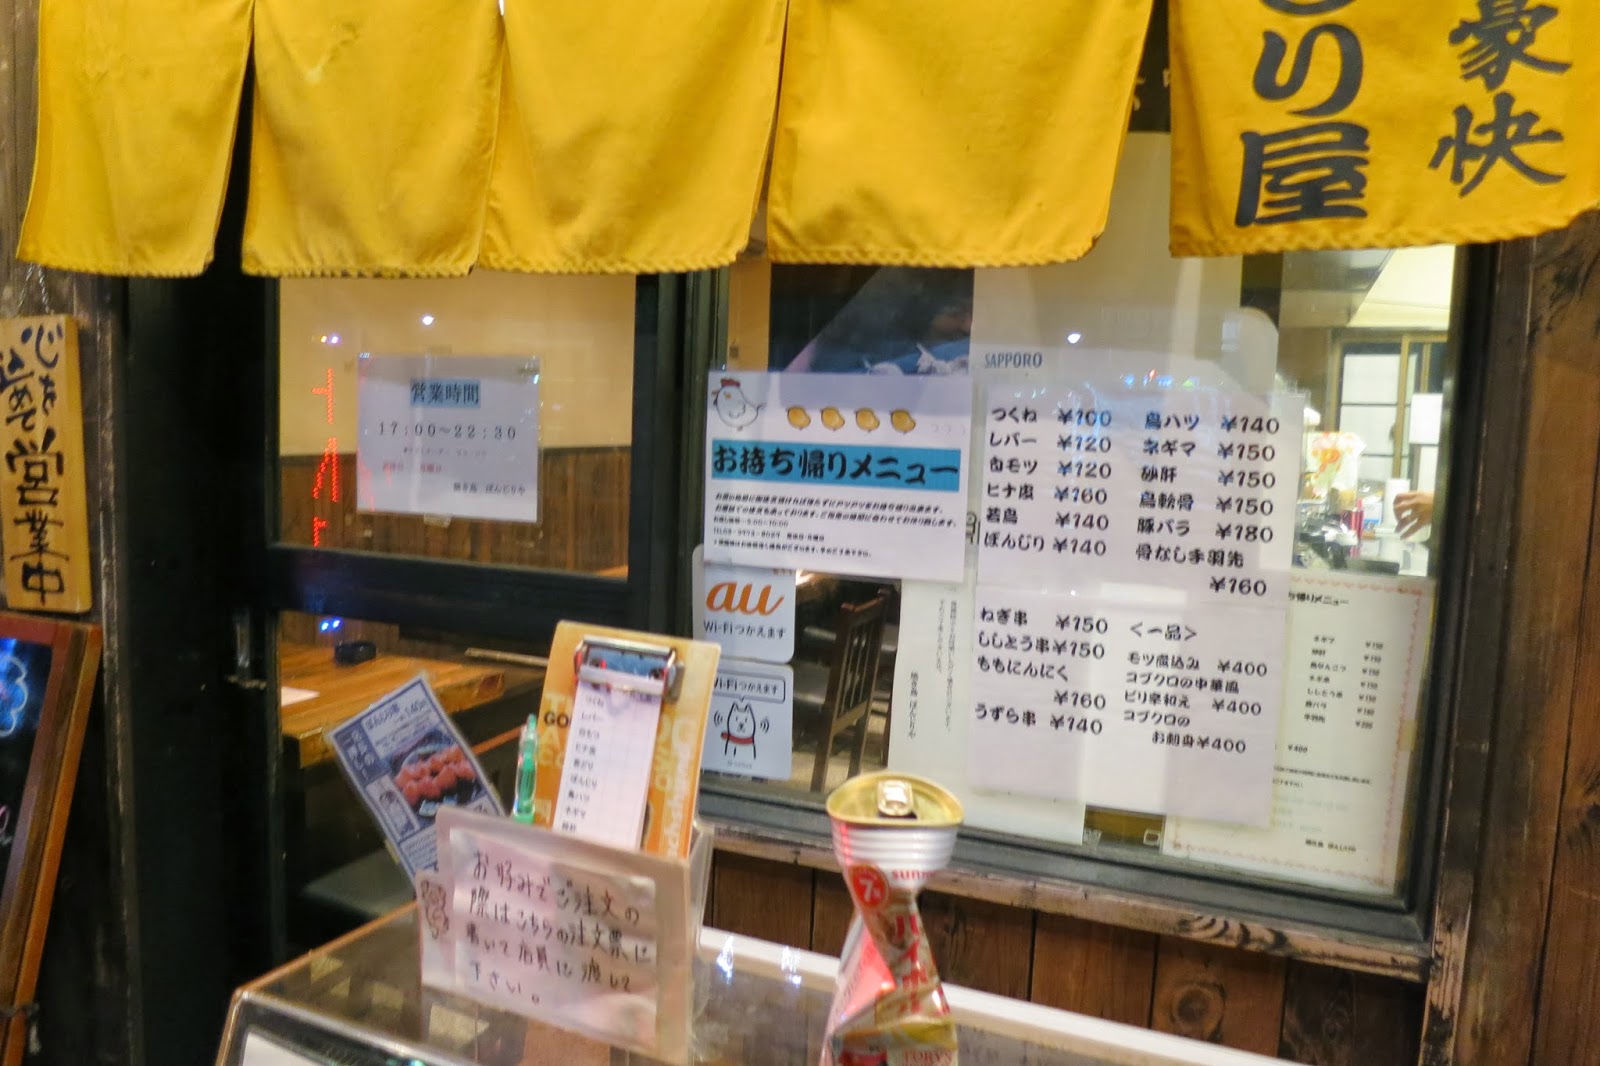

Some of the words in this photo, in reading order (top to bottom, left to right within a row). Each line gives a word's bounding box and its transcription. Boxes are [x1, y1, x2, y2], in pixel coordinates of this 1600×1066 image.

[1233, 0, 1370, 228] り屋
[984, 352, 1043, 368] SAPPORO
[411, 382, 479, 404] 営業時間
[992, 406, 1037, 423] つくね
[1057, 409, 1112, 427] ¥100
[1145, 411, 1199, 430] 鳥ハツ
[1220, 415, 1280, 435] ¥140
[989, 432, 1037, 447] レバー
[1057, 436, 1111, 452] ¥120
[1143, 437, 1196, 456] ネギマ
[1217, 443, 1275, 461] ¥150
[713, 445, 958, 485] お持ち帰りメニュー
[990, 456, 1037, 474] 白モツ
[1057, 461, 1111, 479] ¥120
[1141, 465, 1177, 483] 砂肝
[1218, 470, 1276, 489] ¥150
[987, 483, 1034, 500] ヒナ皮
[1054, 487, 1107, 505] ¥160
[1139, 491, 1194, 511] 鳥軟骨
[1215, 497, 1274, 516] ¥150
[986, 507, 1018, 524] 若鳥
[1055, 512, 1109, 530] ¥140
[1137, 518, 1190, 537] 豚バラ
[1215, 524, 1273, 544] ¥180
[984, 532, 1044, 551] ぼんじり
[1053, 538, 1106, 556] ¥140
[1136, 543, 1244, 568] 骨なし手羽先
[1209, 576, 1267, 596] ¥160
[706, 581, 784, 616] au
[980, 607, 1028, 627] ねぎ串
[1055, 615, 1108, 635] ¥150
[978, 631, 1049, 653] ししとう串
[1052, 638, 1105, 659] ¥150
[977, 656, 1069, 682] ももにんにく
[1128, 651, 1200, 671] モツ煮込み
[1217, 659, 1268, 677] ¥400
[1126, 671, 1239, 694] コブクロの中華風
[1054, 690, 1106, 710] ¥160
[1212, 698, 1262, 716] ¥400
[975, 703, 1036, 727] うずら串
[1050, 715, 1103, 735] ¥140
[1123, 709, 1190, 727] コブクロの
[1152, 731, 1195, 749] お刺身
[1196, 736, 1246, 754] ¥400
